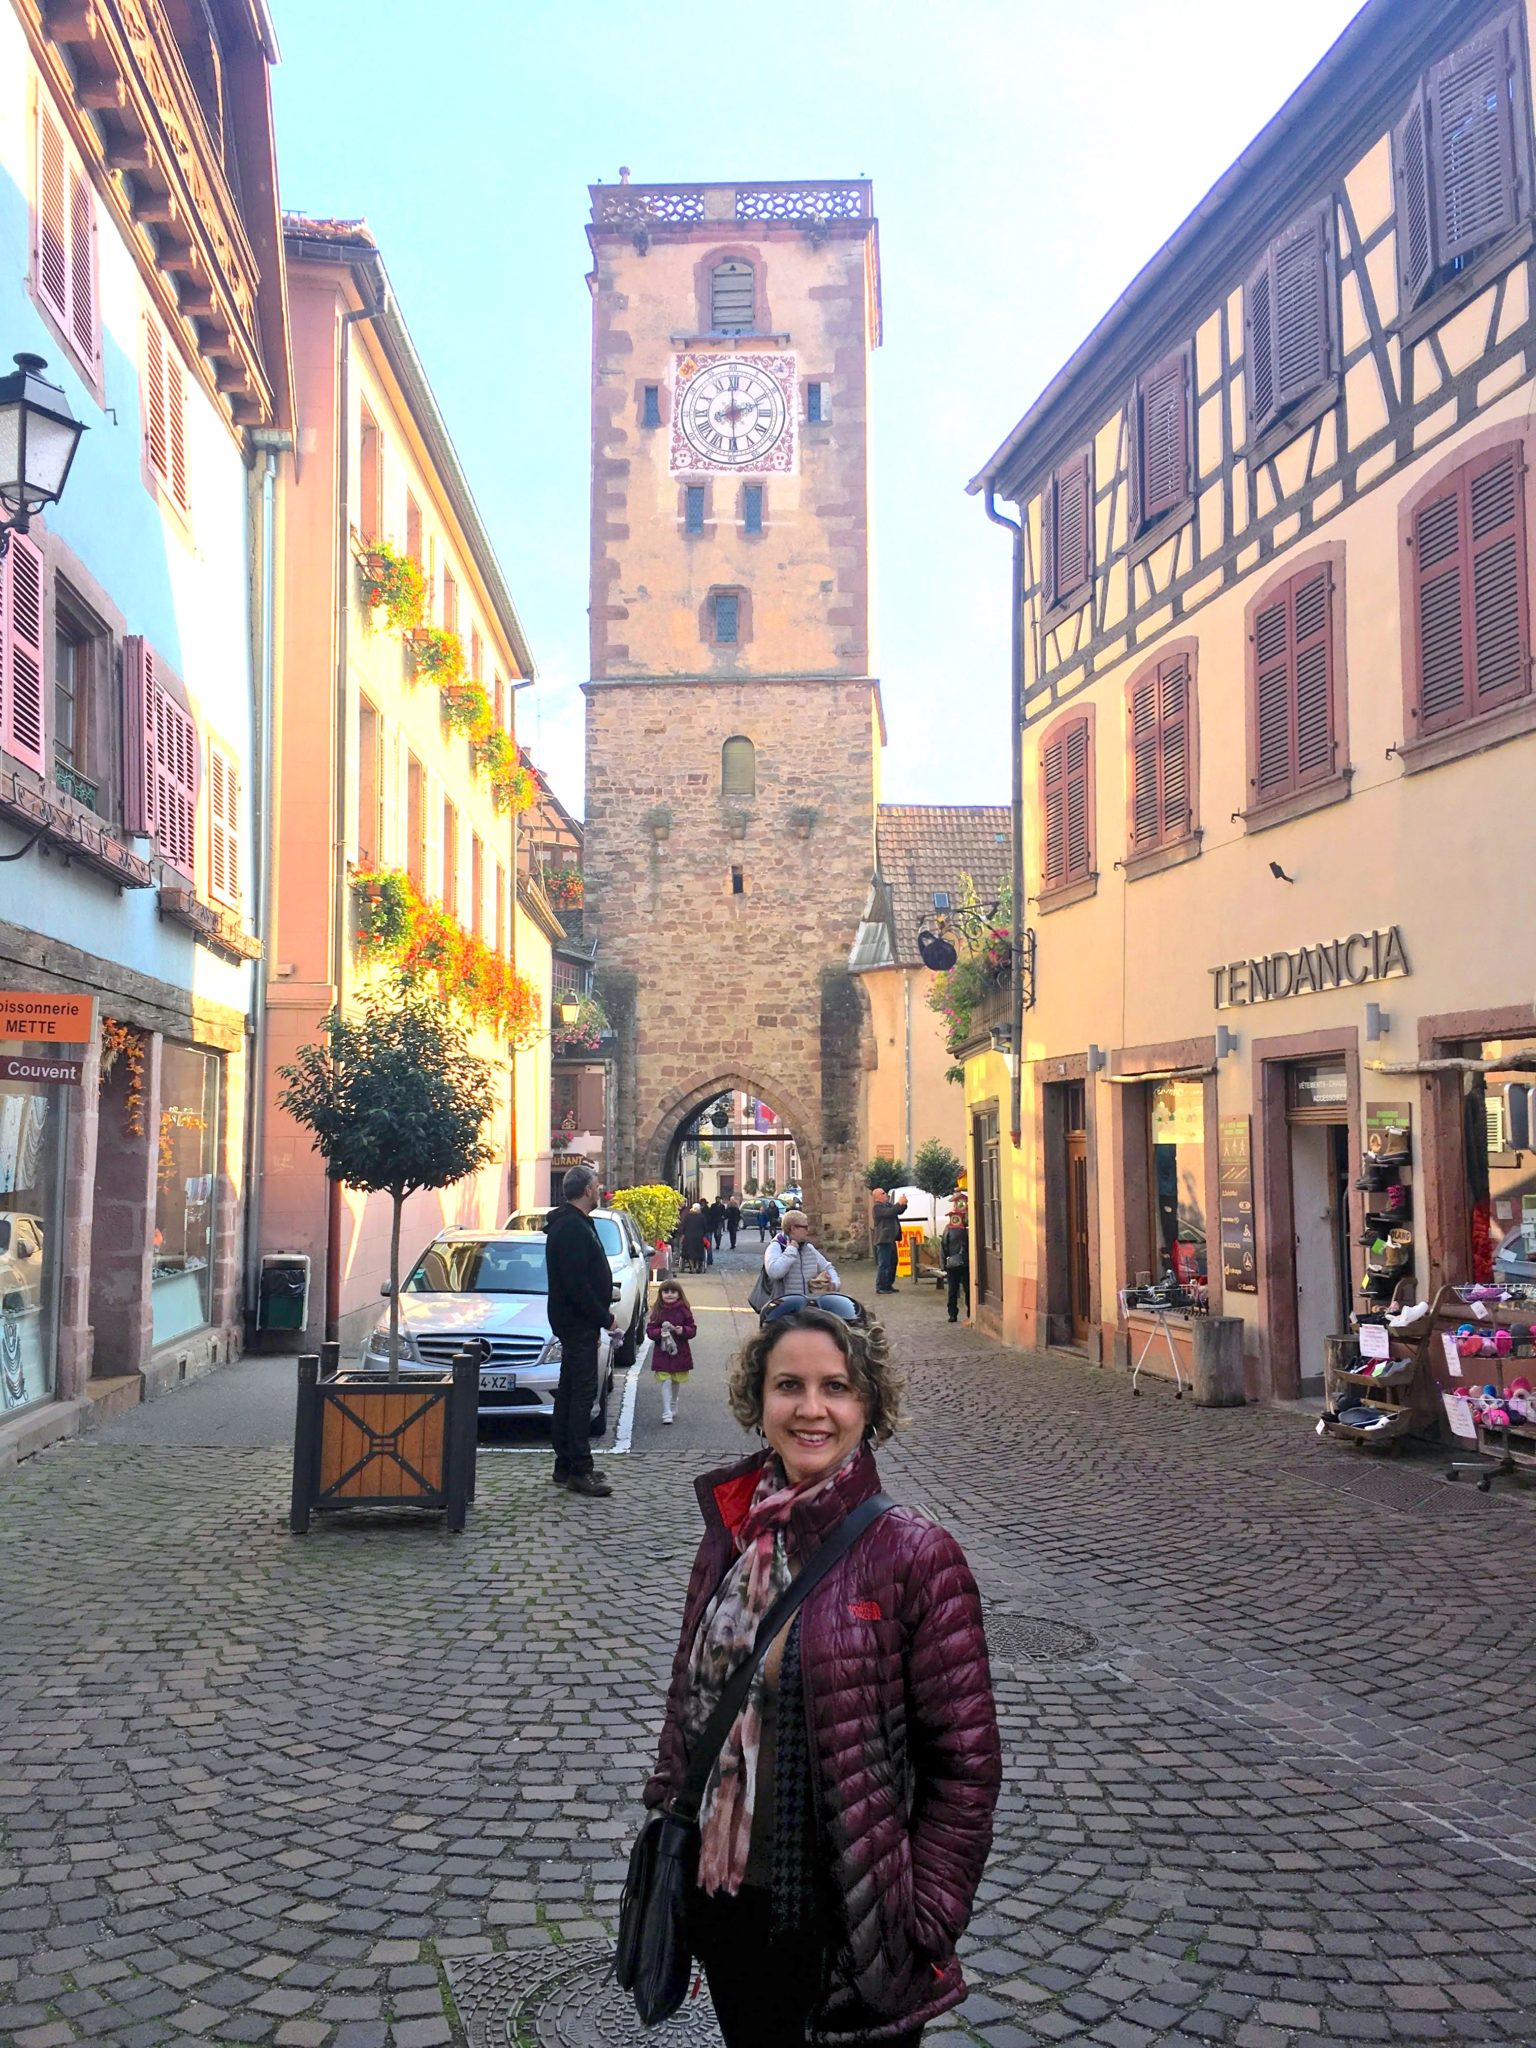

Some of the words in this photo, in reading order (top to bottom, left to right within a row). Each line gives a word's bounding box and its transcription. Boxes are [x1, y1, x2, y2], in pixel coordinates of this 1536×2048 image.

[754, 393, 767, 403] II
[758, 409, 771, 418] III
[1208, 926, 1409, 1009] TENDANCIA
[6, 1020, 56, 1034] METTE
[8, 1061, 76, 1079] Couvent
